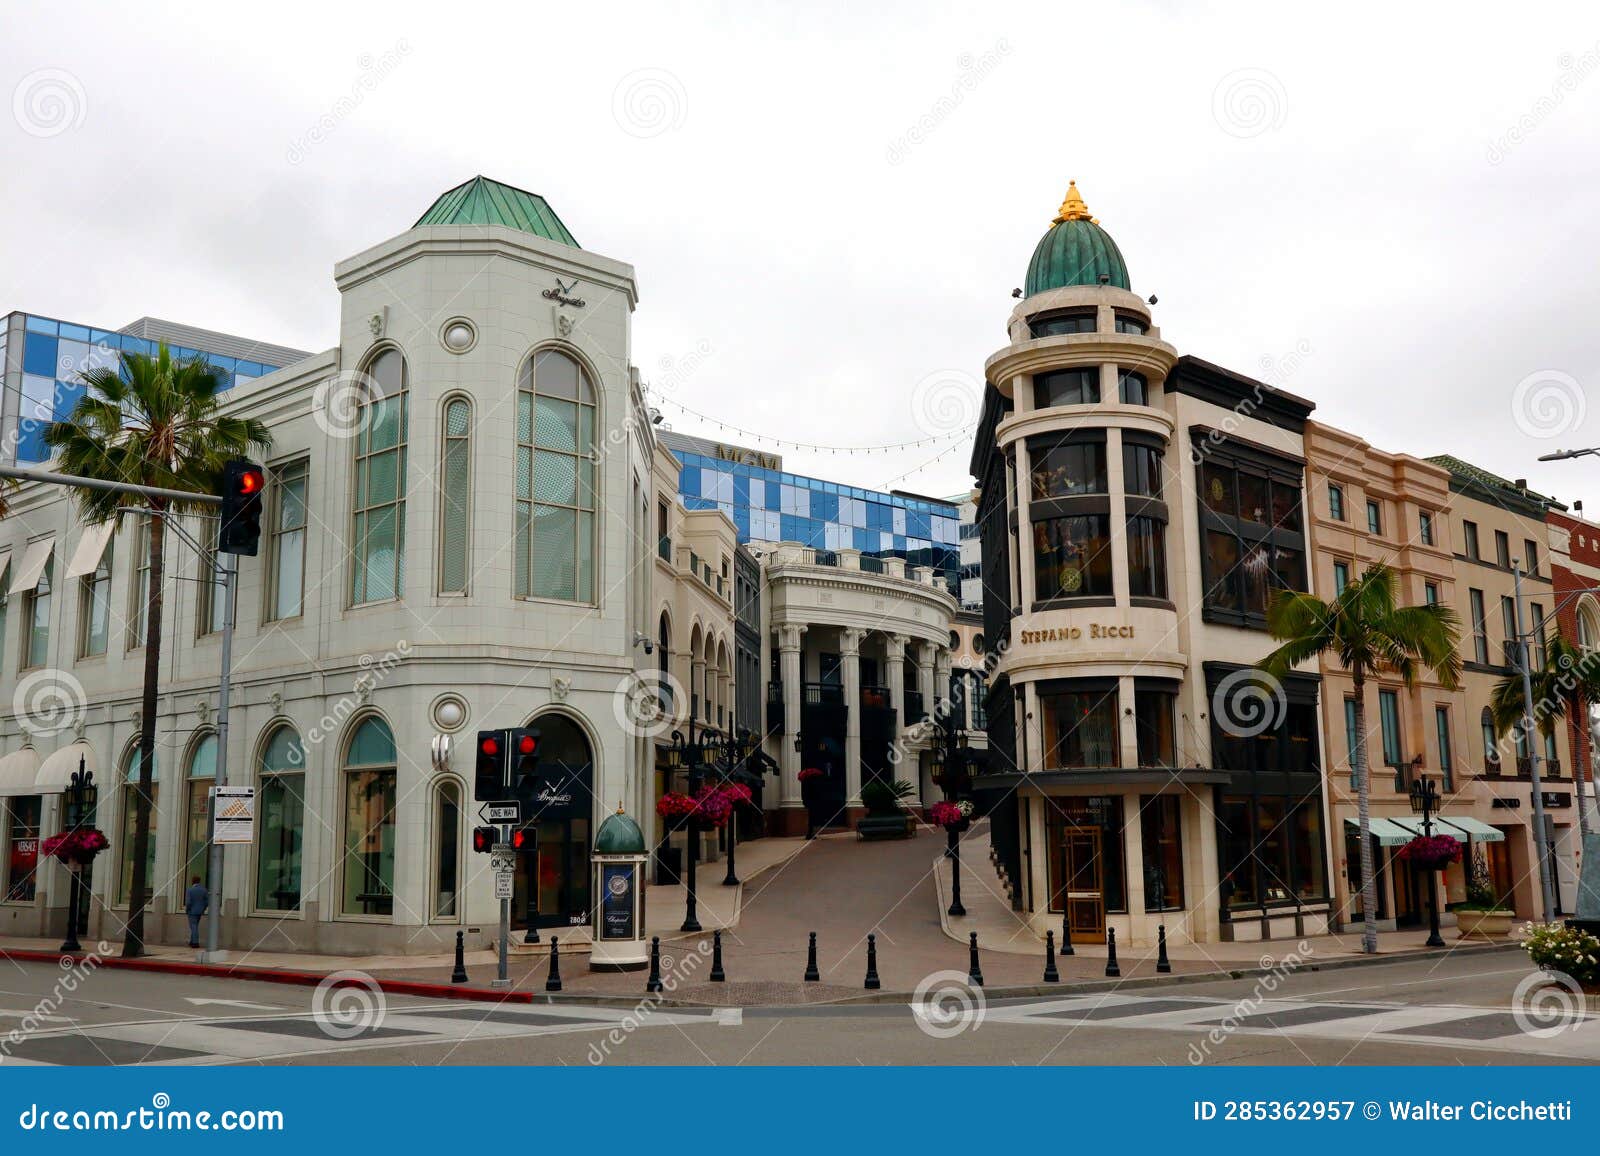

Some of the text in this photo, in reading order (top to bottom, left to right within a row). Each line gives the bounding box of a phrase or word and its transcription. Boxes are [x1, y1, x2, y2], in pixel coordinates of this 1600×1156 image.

[1021, 623, 1135, 645] STEFANO RICCI
[490, 808, 515, 818] ONE WAY
[491, 859, 501, 868] OK
